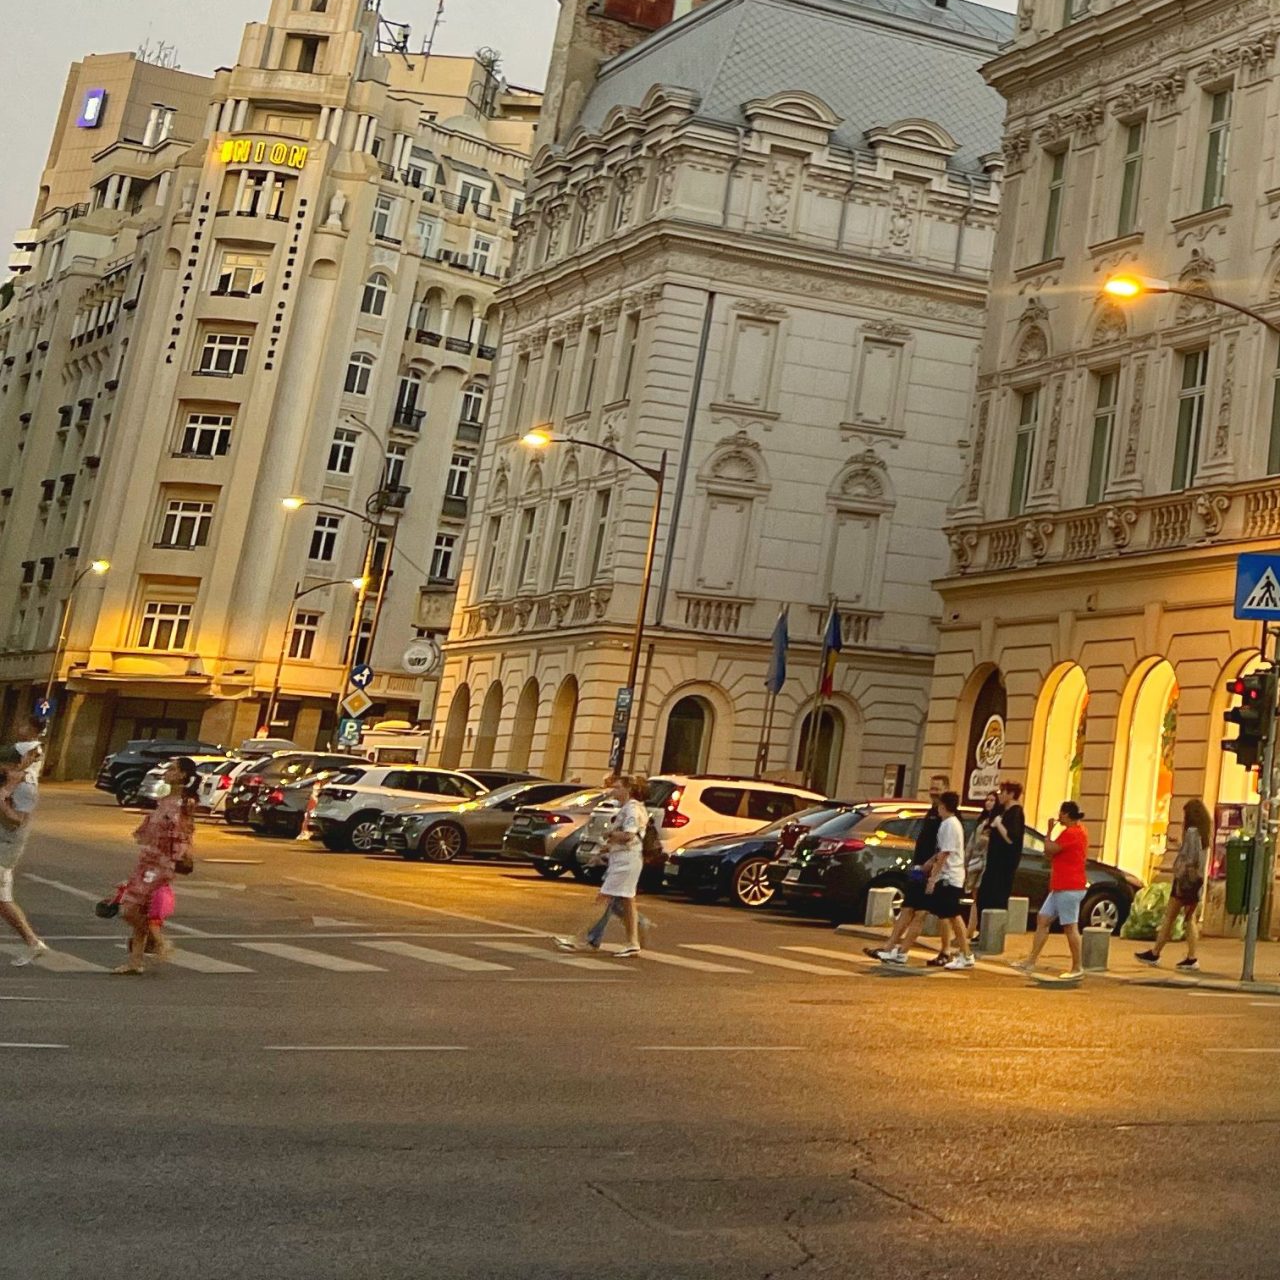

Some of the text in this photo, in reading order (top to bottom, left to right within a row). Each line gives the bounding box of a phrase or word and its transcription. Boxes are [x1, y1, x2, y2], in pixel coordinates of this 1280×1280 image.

[221, 140, 308, 169] UNION
[165, 191, 211, 365] INTERNATIONAL
[264, 198, 308, 371] BUSINESS CENTER
